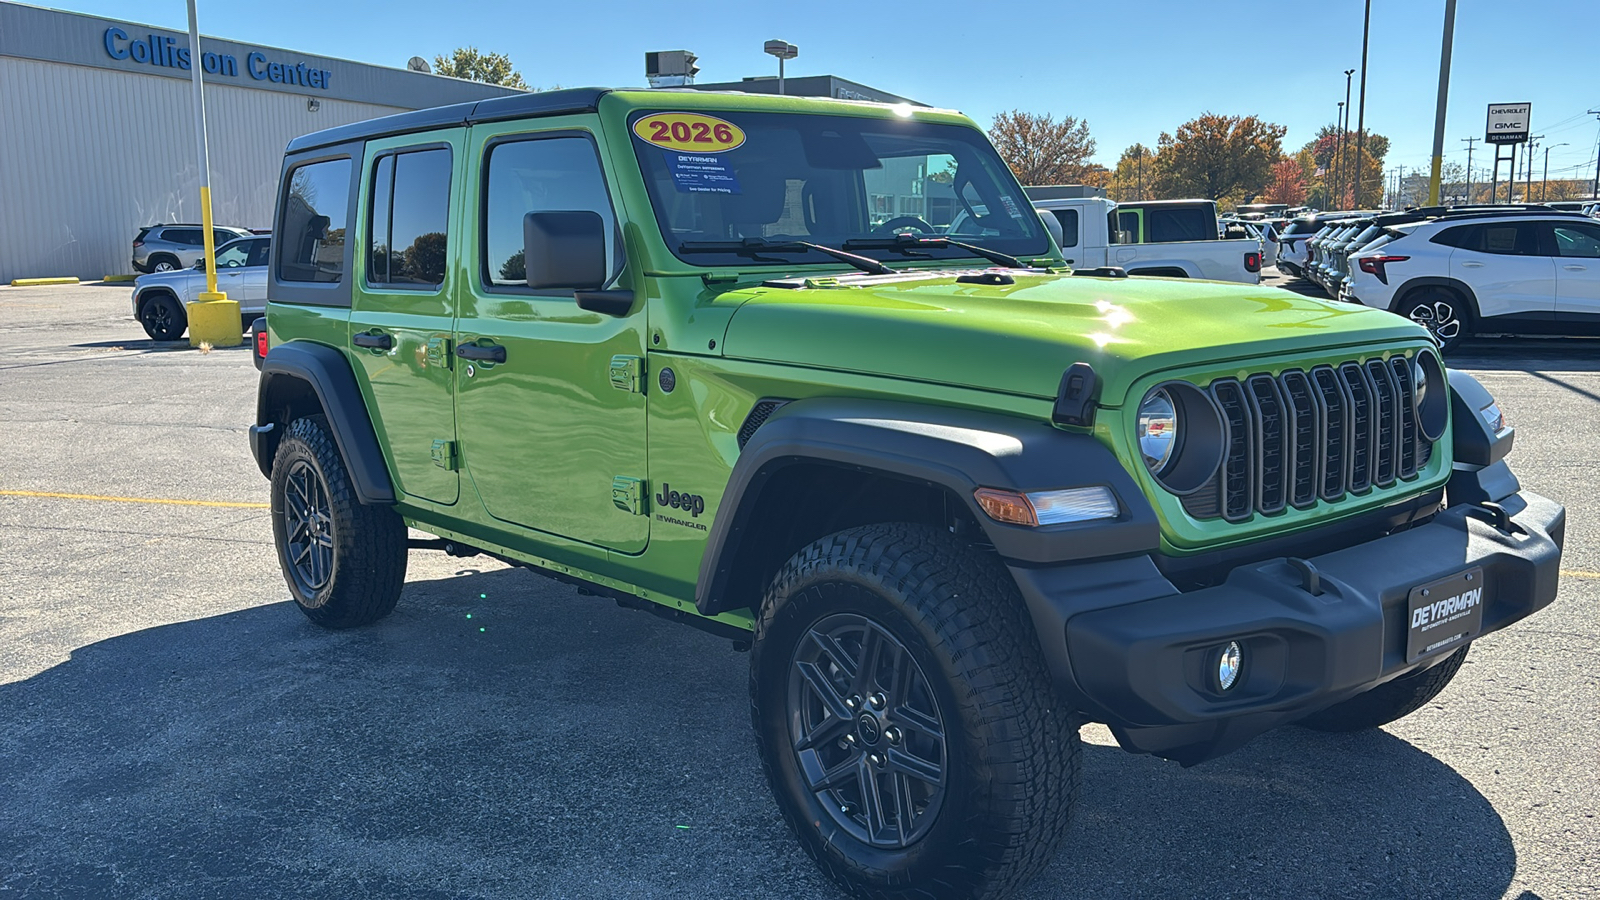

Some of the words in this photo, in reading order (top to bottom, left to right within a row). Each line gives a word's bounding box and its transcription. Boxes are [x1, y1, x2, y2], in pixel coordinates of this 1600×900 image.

[105, 27, 238, 77] Collison
[249, 51, 331, 89] Center
[649, 121, 734, 143] 2026
[656, 482, 704, 517] Jeep
[663, 516, 707, 531] WRANGLER
[1411, 587, 1482, 629] DEYARMAN
